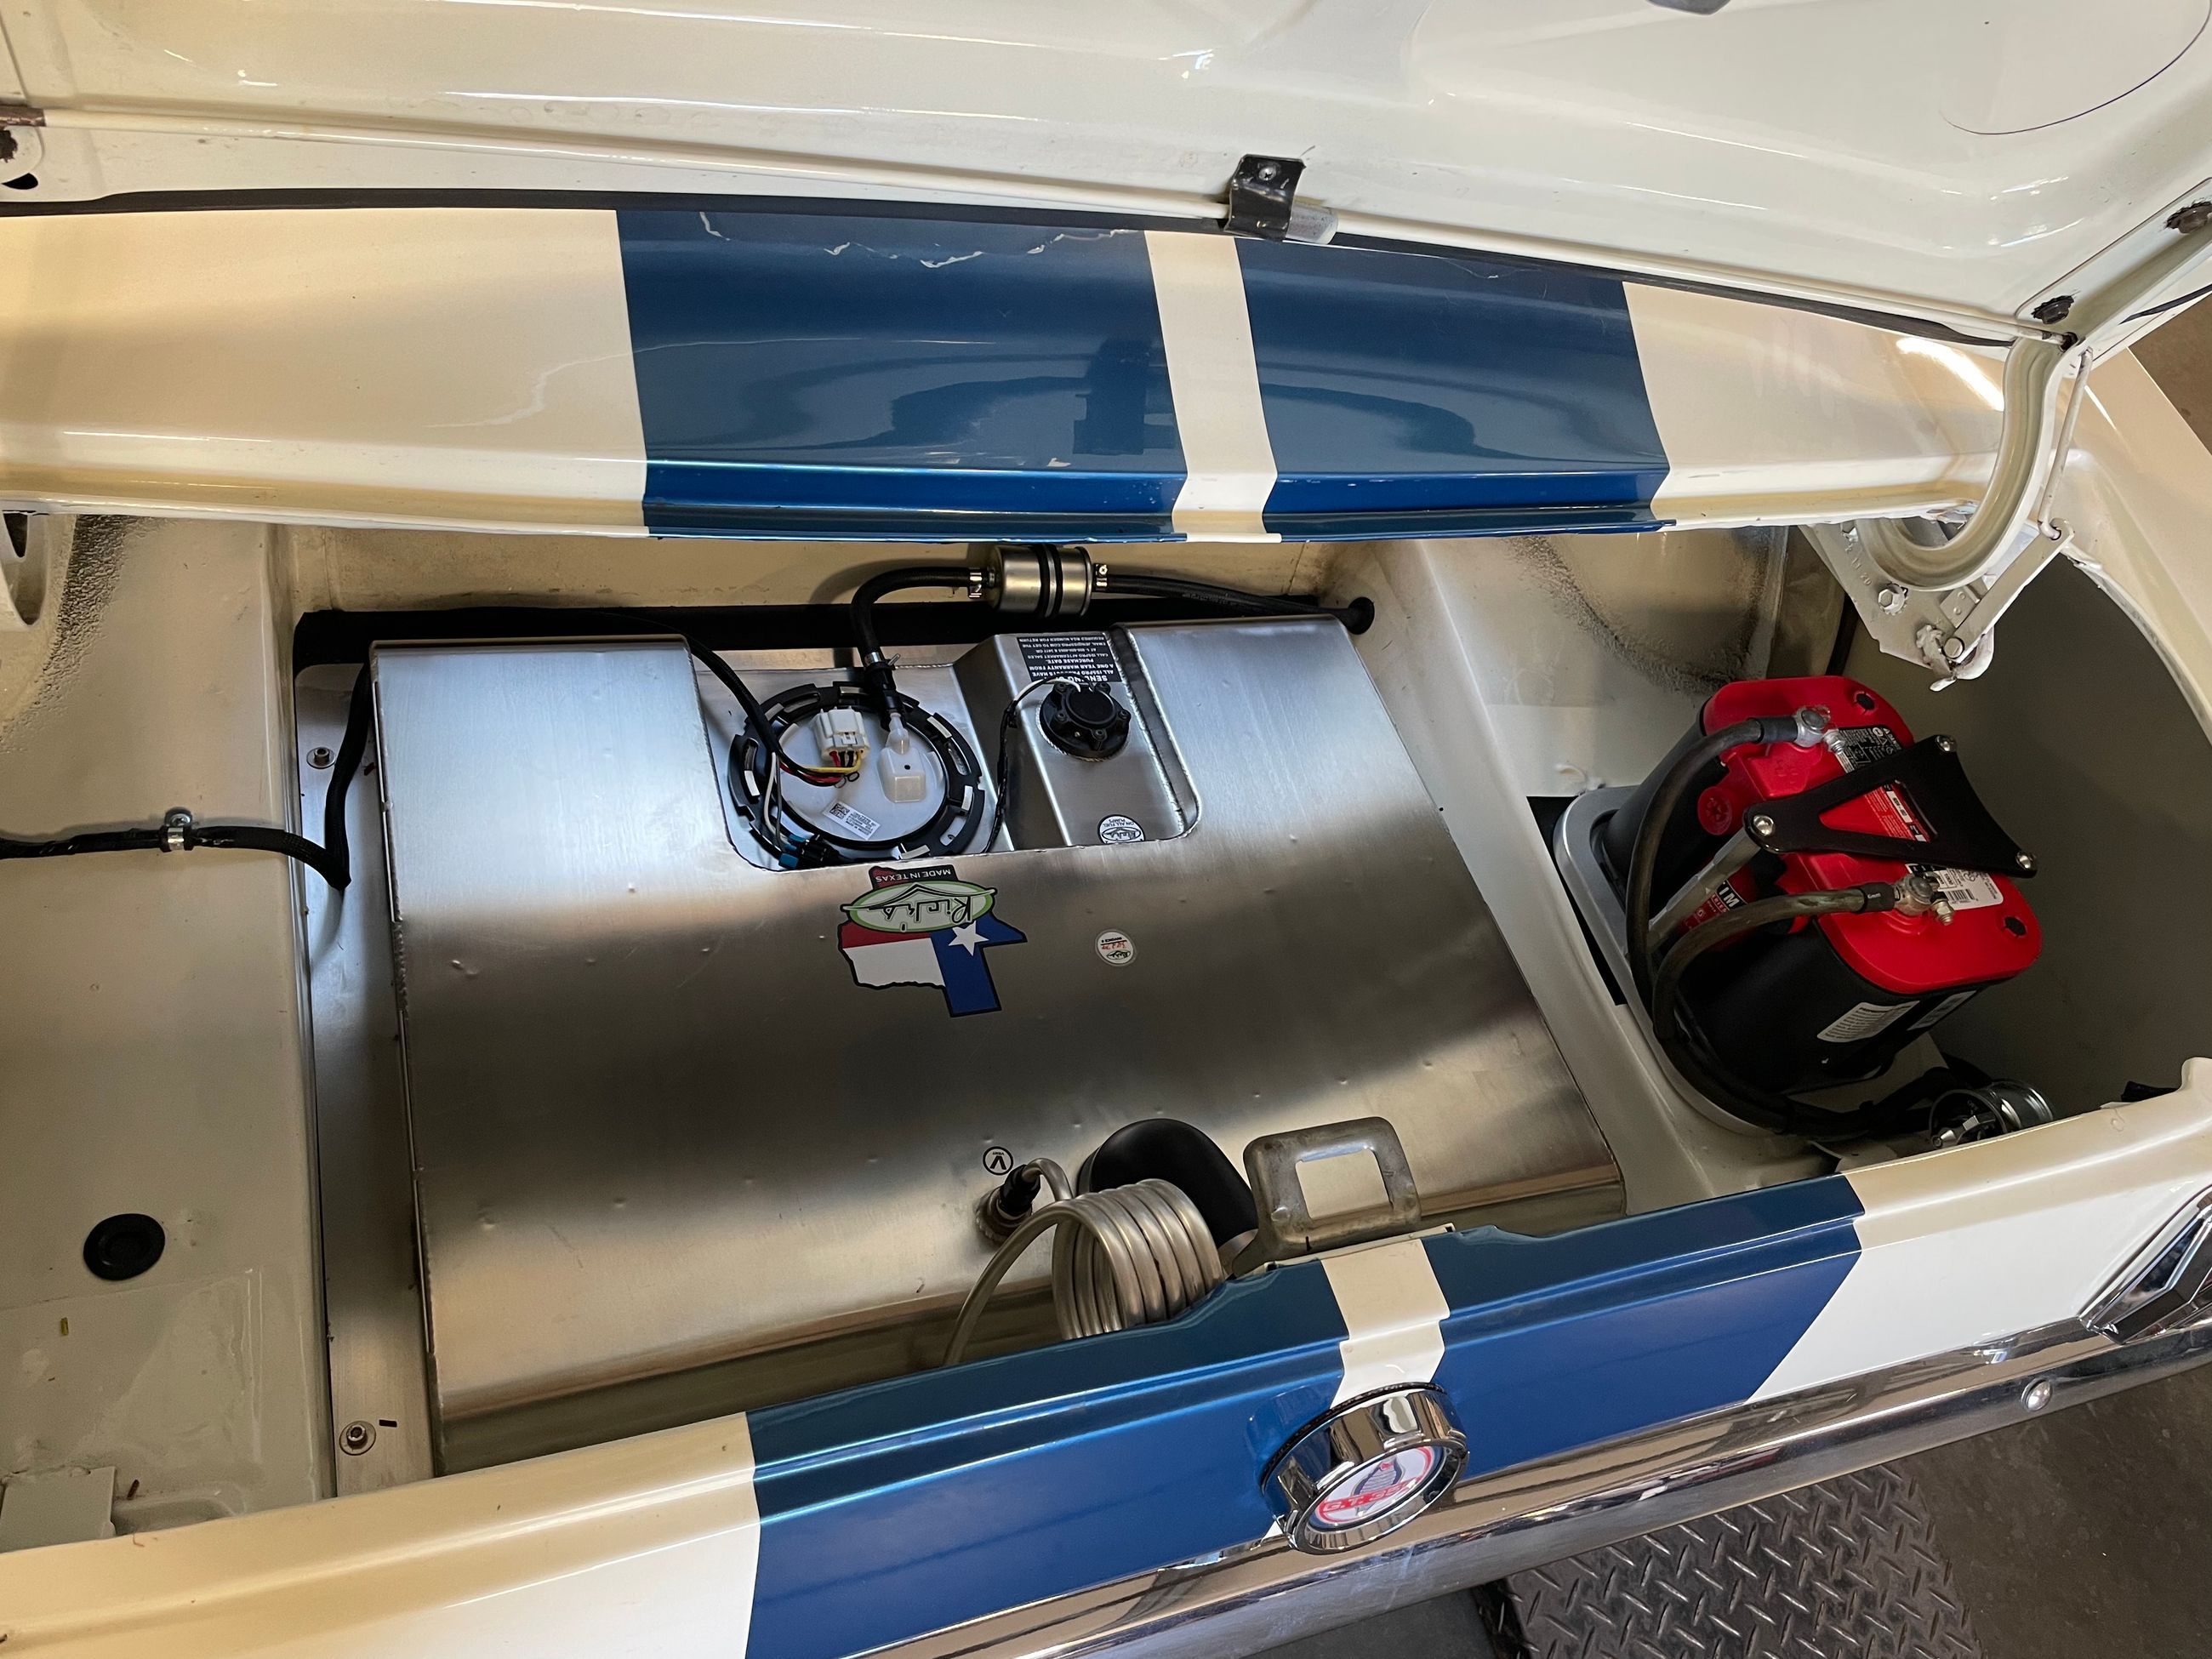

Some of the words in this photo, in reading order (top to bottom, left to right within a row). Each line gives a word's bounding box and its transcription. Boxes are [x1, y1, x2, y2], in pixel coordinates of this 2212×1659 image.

[875, 874, 909, 883] TEXAS
[921, 869, 951, 879] MADE
[869, 896, 971, 932] Rick's
[989, 1155, 1006, 1170] V
